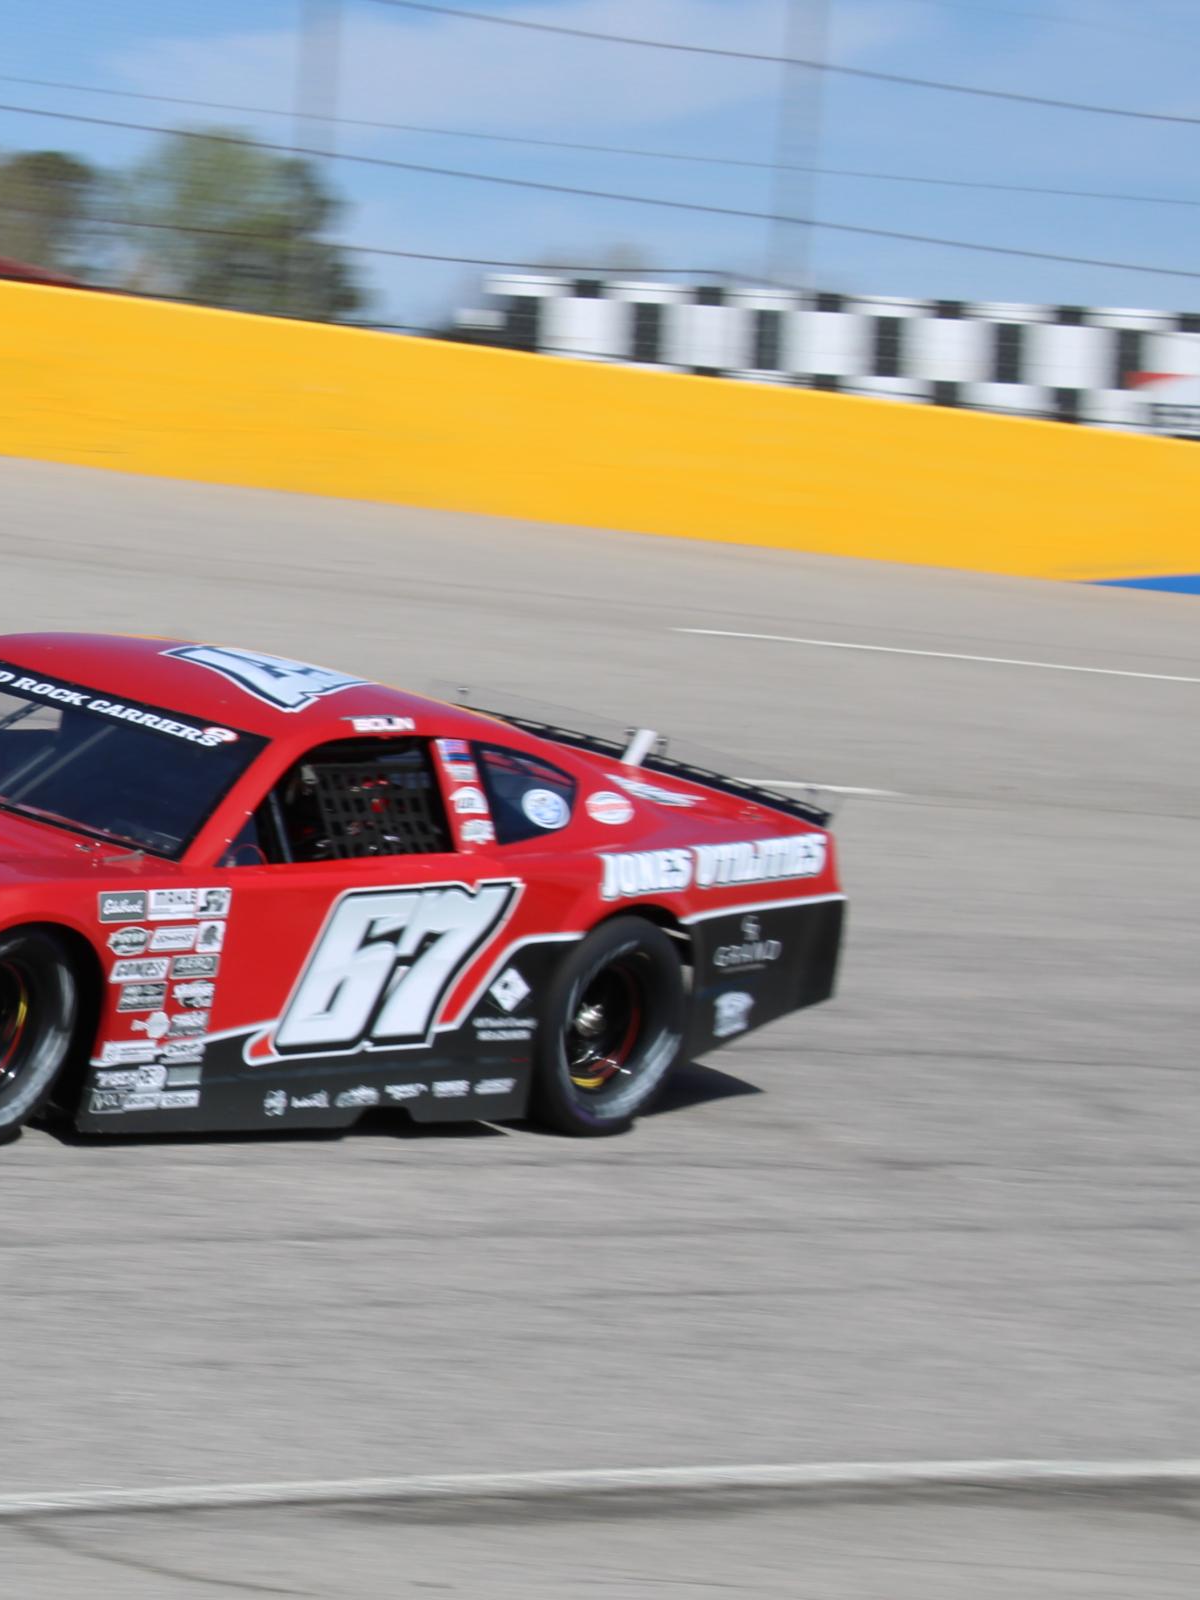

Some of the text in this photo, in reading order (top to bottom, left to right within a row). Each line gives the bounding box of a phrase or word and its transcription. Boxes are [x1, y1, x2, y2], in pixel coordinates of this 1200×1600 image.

[10, 676, 92, 707] ROCK
[87, 698, 224, 747] CARRIERS
[598, 832, 828, 902] JONES UTILITIES
[274, 880, 518, 1055] 67
